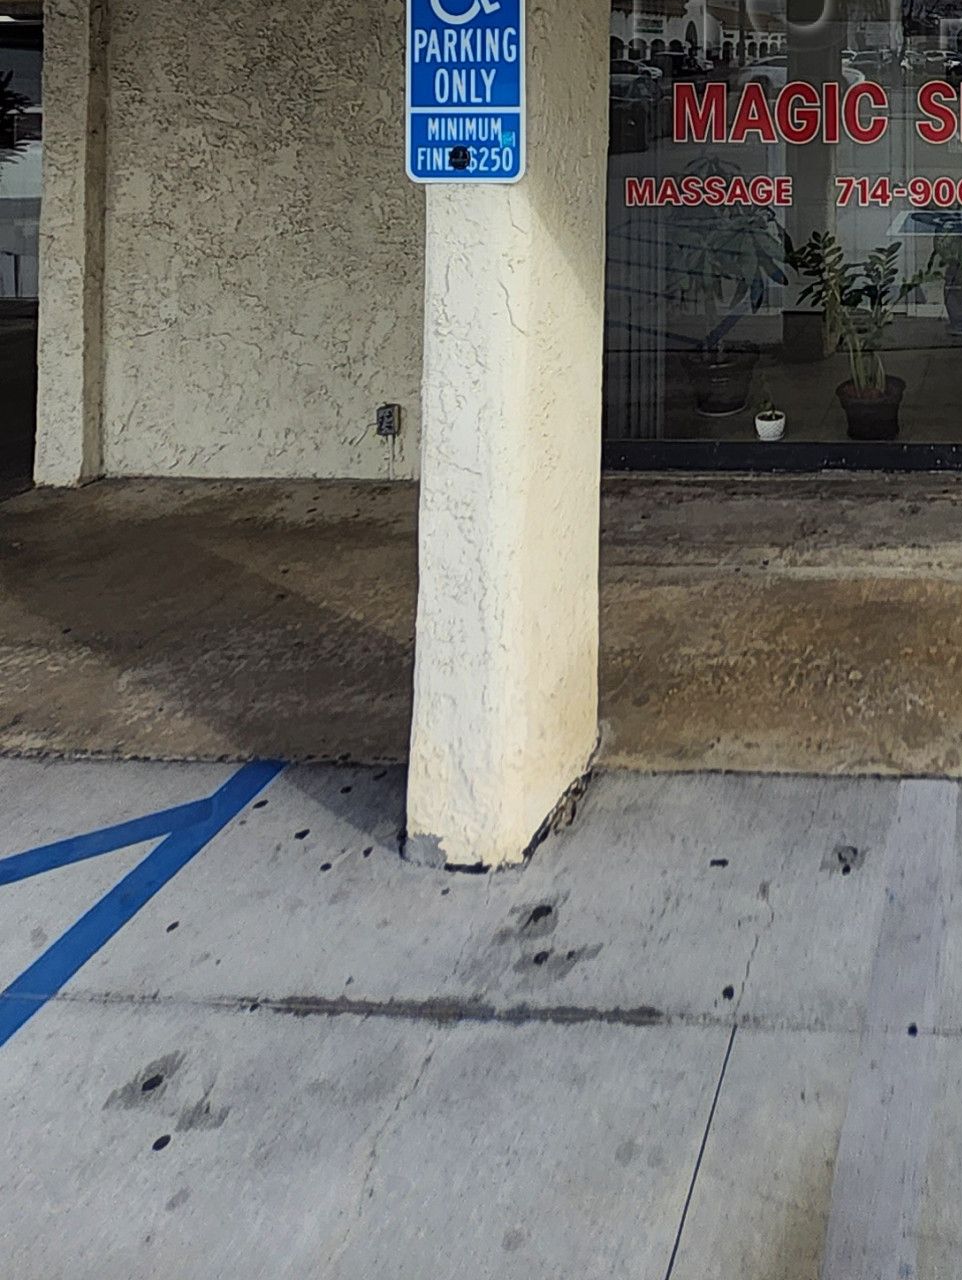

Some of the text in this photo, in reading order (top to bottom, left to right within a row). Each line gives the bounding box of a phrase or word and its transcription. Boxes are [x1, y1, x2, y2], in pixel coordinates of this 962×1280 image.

[414, 27, 517, 63] PARKING
[434, 69, 497, 104] ONLY
[673, 81, 889, 144] MAGIC
[427, 117, 502, 141] MINIMUM
[417, 145, 513, 173] FINE $250
[625, 177, 794, 207] MASSAGE
